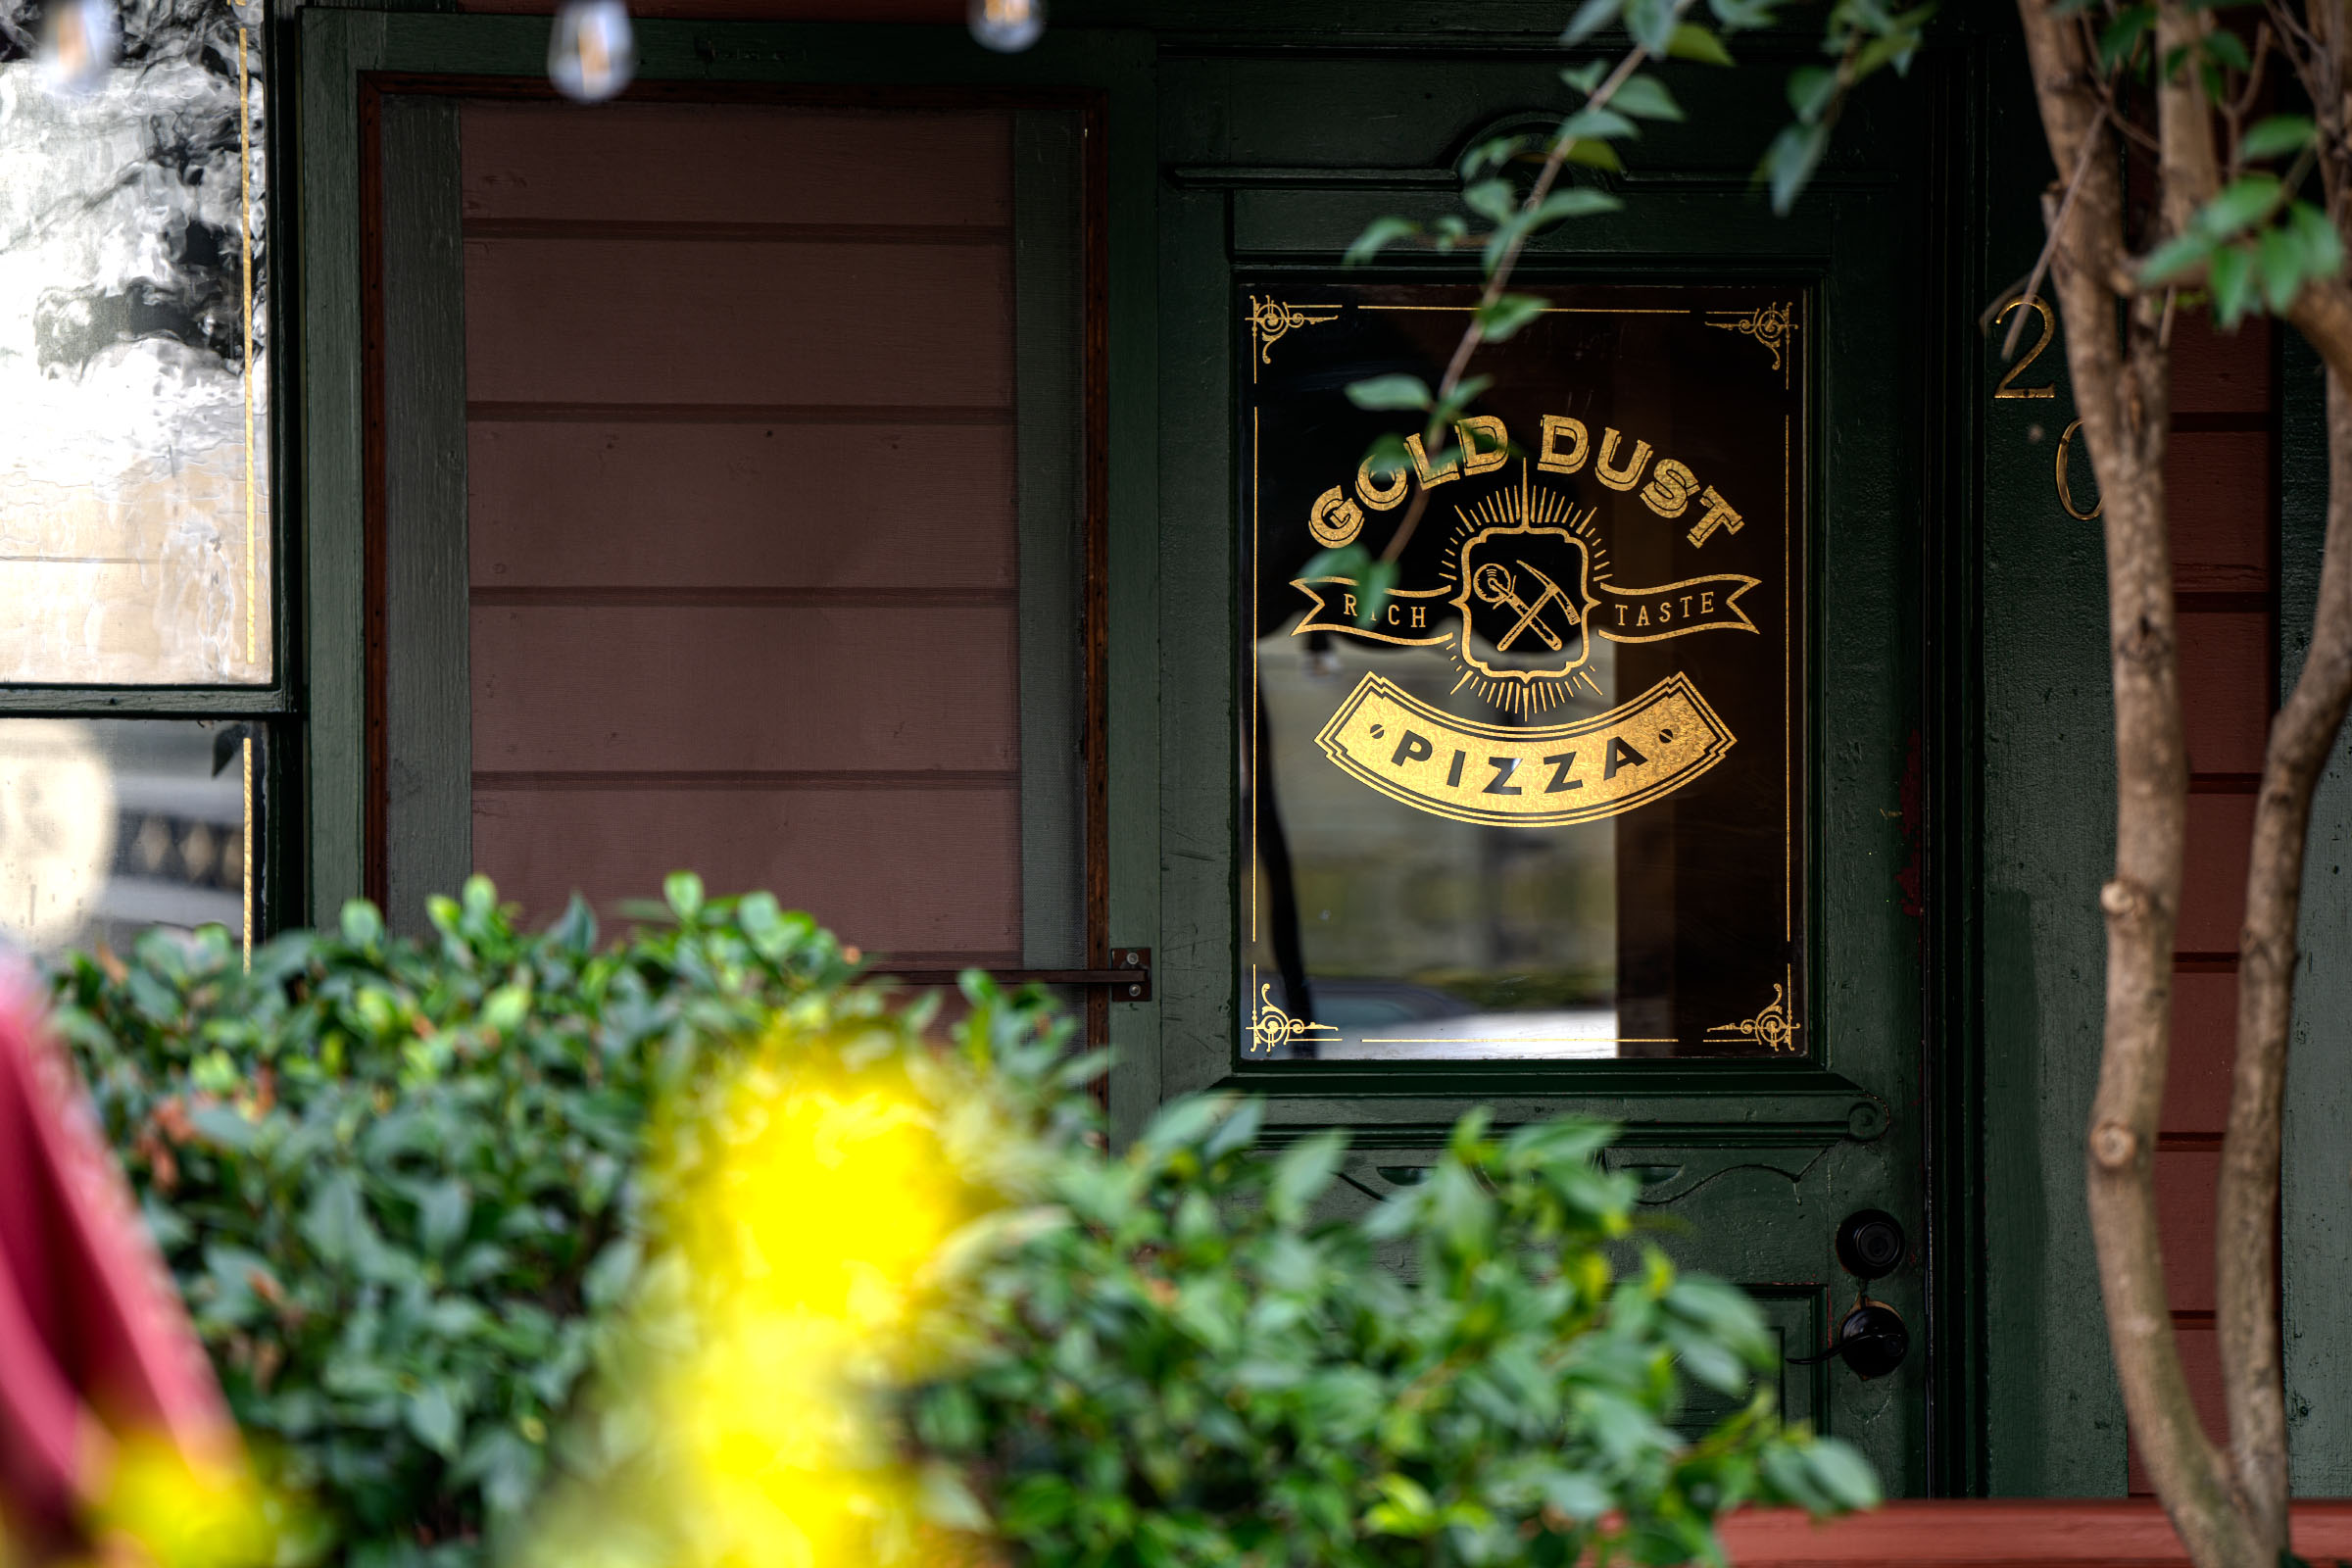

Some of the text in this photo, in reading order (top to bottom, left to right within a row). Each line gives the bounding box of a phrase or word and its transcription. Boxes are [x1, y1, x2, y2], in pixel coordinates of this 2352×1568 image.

[1993, 294, 2055, 399] 2
[1308, 414, 1744, 549] GOLD DUST
[1615, 591, 1714, 626] TASTE
[1391, 729, 1648, 796] PIZZA
